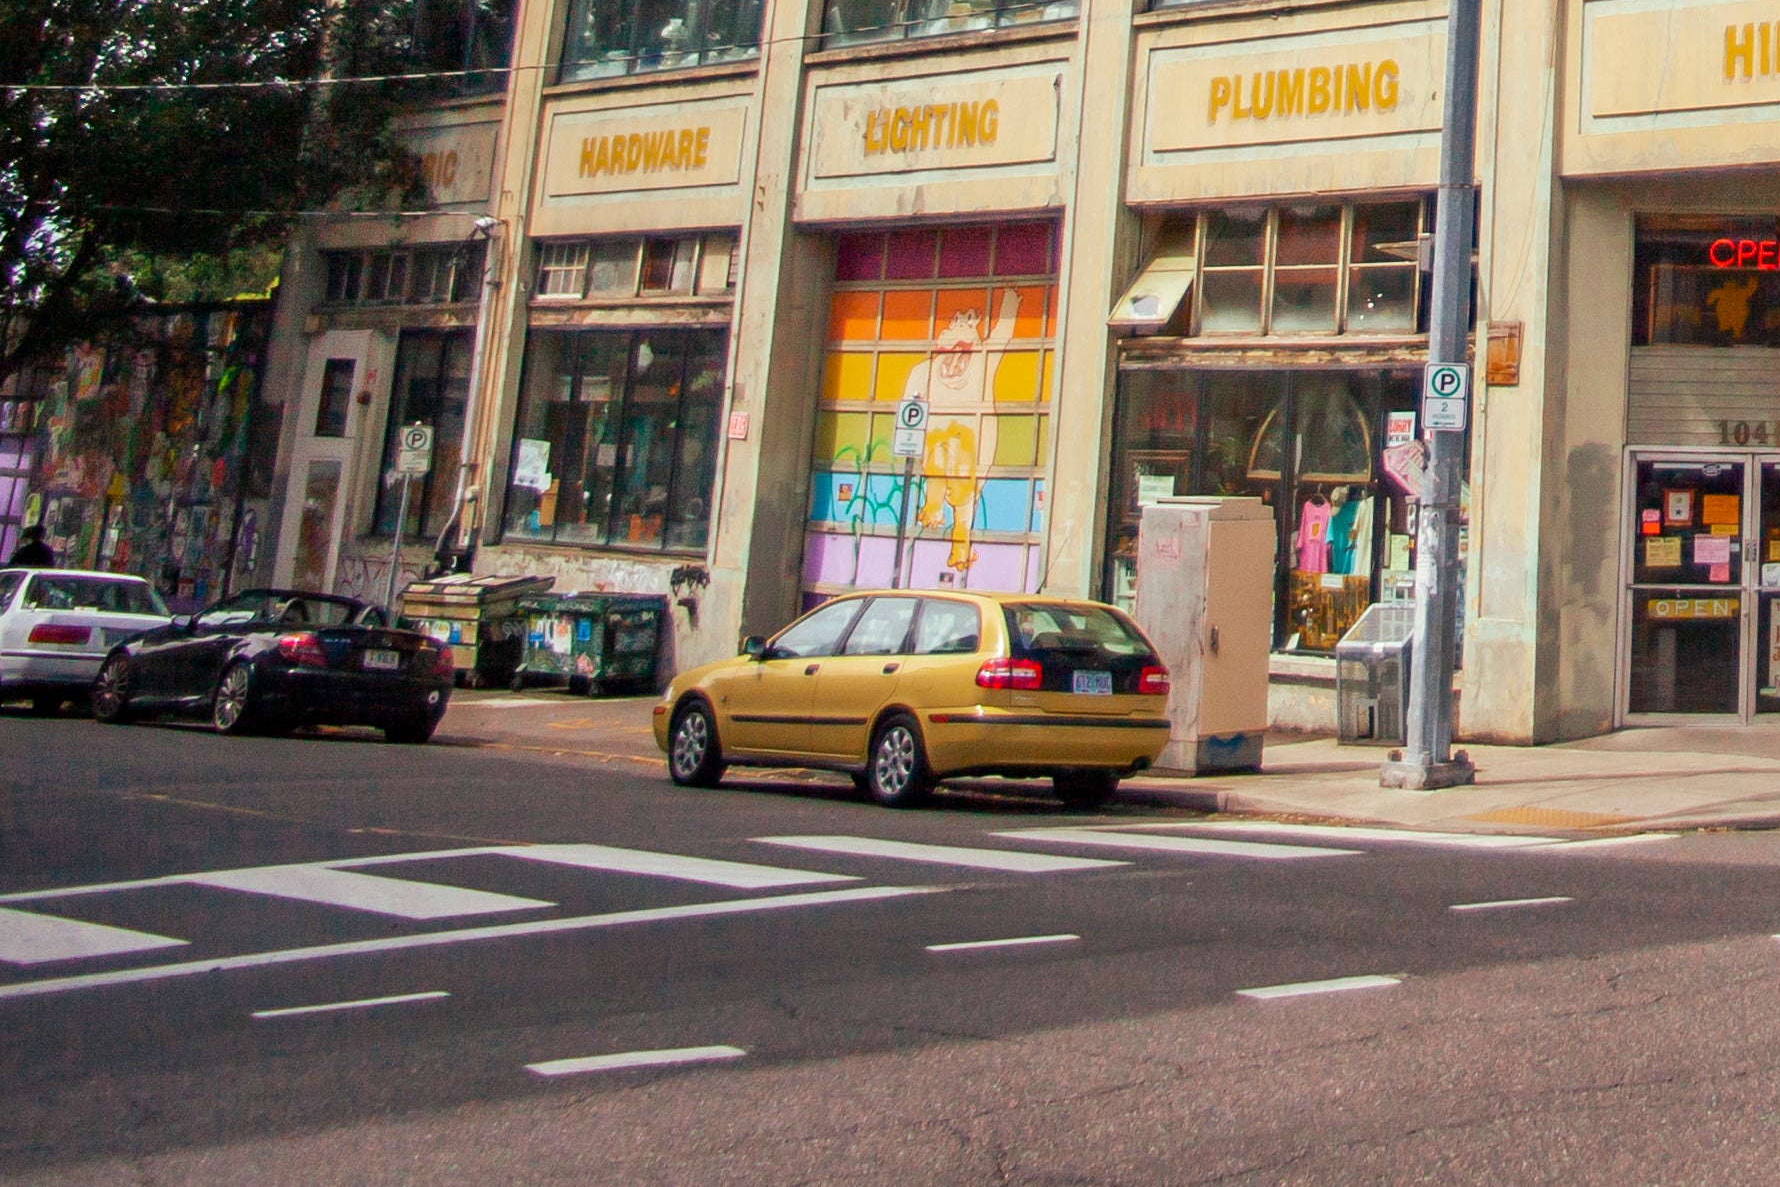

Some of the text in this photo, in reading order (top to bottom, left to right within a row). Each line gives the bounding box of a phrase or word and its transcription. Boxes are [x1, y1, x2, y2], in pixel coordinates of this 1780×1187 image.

[1209, 59, 1400, 126] PLUMBING
[863, 98, 999, 156] LIGHTING
[579, 126, 711, 179] HARDWARE
[1440, 373, 1455, 391] P
[1441, 401, 1449, 412] 2
[908, 408, 919, 423] P
[906, 432, 912, 441] 2
[1655, 599, 1729, 616] OPEN
